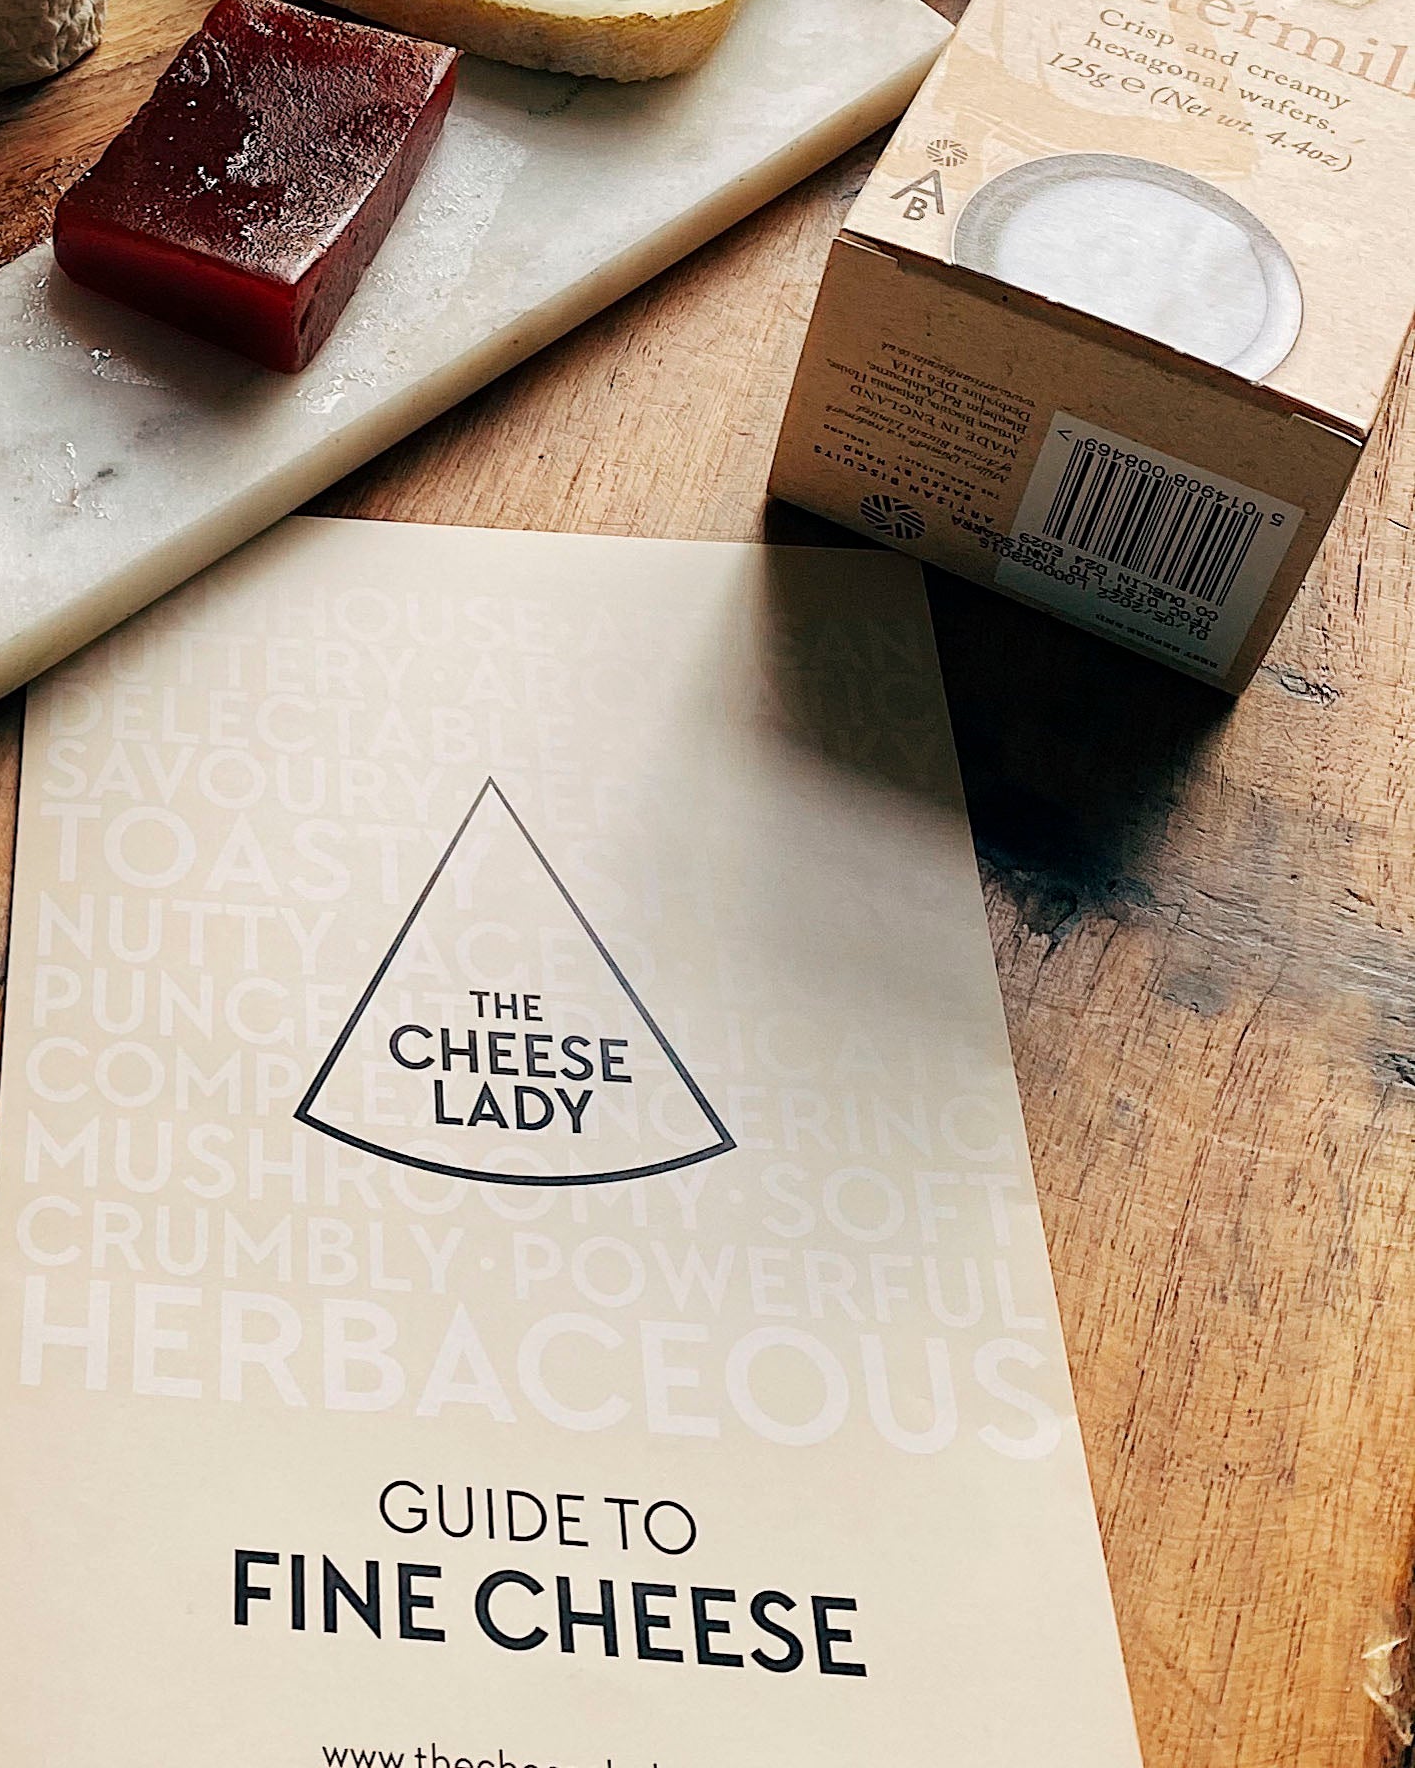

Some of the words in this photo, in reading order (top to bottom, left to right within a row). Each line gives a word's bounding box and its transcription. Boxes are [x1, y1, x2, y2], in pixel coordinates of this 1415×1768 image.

[1099, 8, 1175, 47] Crisp
[1185, 39, 1239, 67] and
[1247, 62, 1352, 111] creamy
[1085, 32, 1229, 93] hexagonal
[1239, 85, 1337, 134] wafers.
[1045, 51, 1111, 88] 125g
[1150, 85, 1213, 118] (Net
[1217, 113, 1254, 137] wt.
[1267, 130, 1354, 173] 4.4oz)
[889, 358, 924, 379] 1HA
[925, 372, 959, 393] DE6
[847, 383, 937, 426] ENGLAND
[868, 376, 925, 406] Britannia
[960, 386, 1032, 422] Derbyshire
[824, 403, 885, 432] trademark
[905, 425, 951, 449] Biscuits
[939, 420, 960, 435] IN
[964, 401, 1028, 434] Blenheim
[977, 421, 1023, 445] Artisan
[811, 444, 900, 486] BISCUITS
[842, 443, 886, 466] HAND
[952, 444, 999, 468] Artisan
[964, 430, 1018, 458] MADE
[1083, 434, 1167, 479] 008469
[893, 464, 912, 477] BY
[919, 475, 972, 501] BAKED
[907, 483, 995, 525] ARTISAN
[1171, 470, 1257, 517] 014908
[1269, 511, 1284, 527] 5
[1073, 553, 1108, 575] D24
[1095, 585, 1209, 641] 01/05/2022
[104, 628, 417, 700] UTTERY
[49, 682, 581, 775] DELECTABLE
[41, 739, 449, 822] SAVOURY
[39, 802, 505, 911] TOASTY
[37, 891, 337, 975] NUTTY
[32, 963, 474, 1054] PUNGENT
[469, 990, 543, 1021] THE
[388, 1024, 633, 1084] CHEESE
[434, 1079, 593, 1134] LADY
[21, 1110, 729, 1232] MUSHROOMY
[760, 1163, 1022, 1249] SOFT
[15, 1194, 465, 1295] CRUMBLY
[513, 1230, 1052, 1332] POWERFUL
[16, 1274, 1065, 1461] HERBACEOUS
[379, 1480, 589, 1547] GUIDE
[604, 1496, 698, 1556] TO
[232, 1548, 446, 1642] FINE
[474, 1569, 869, 1678] CHEESE
